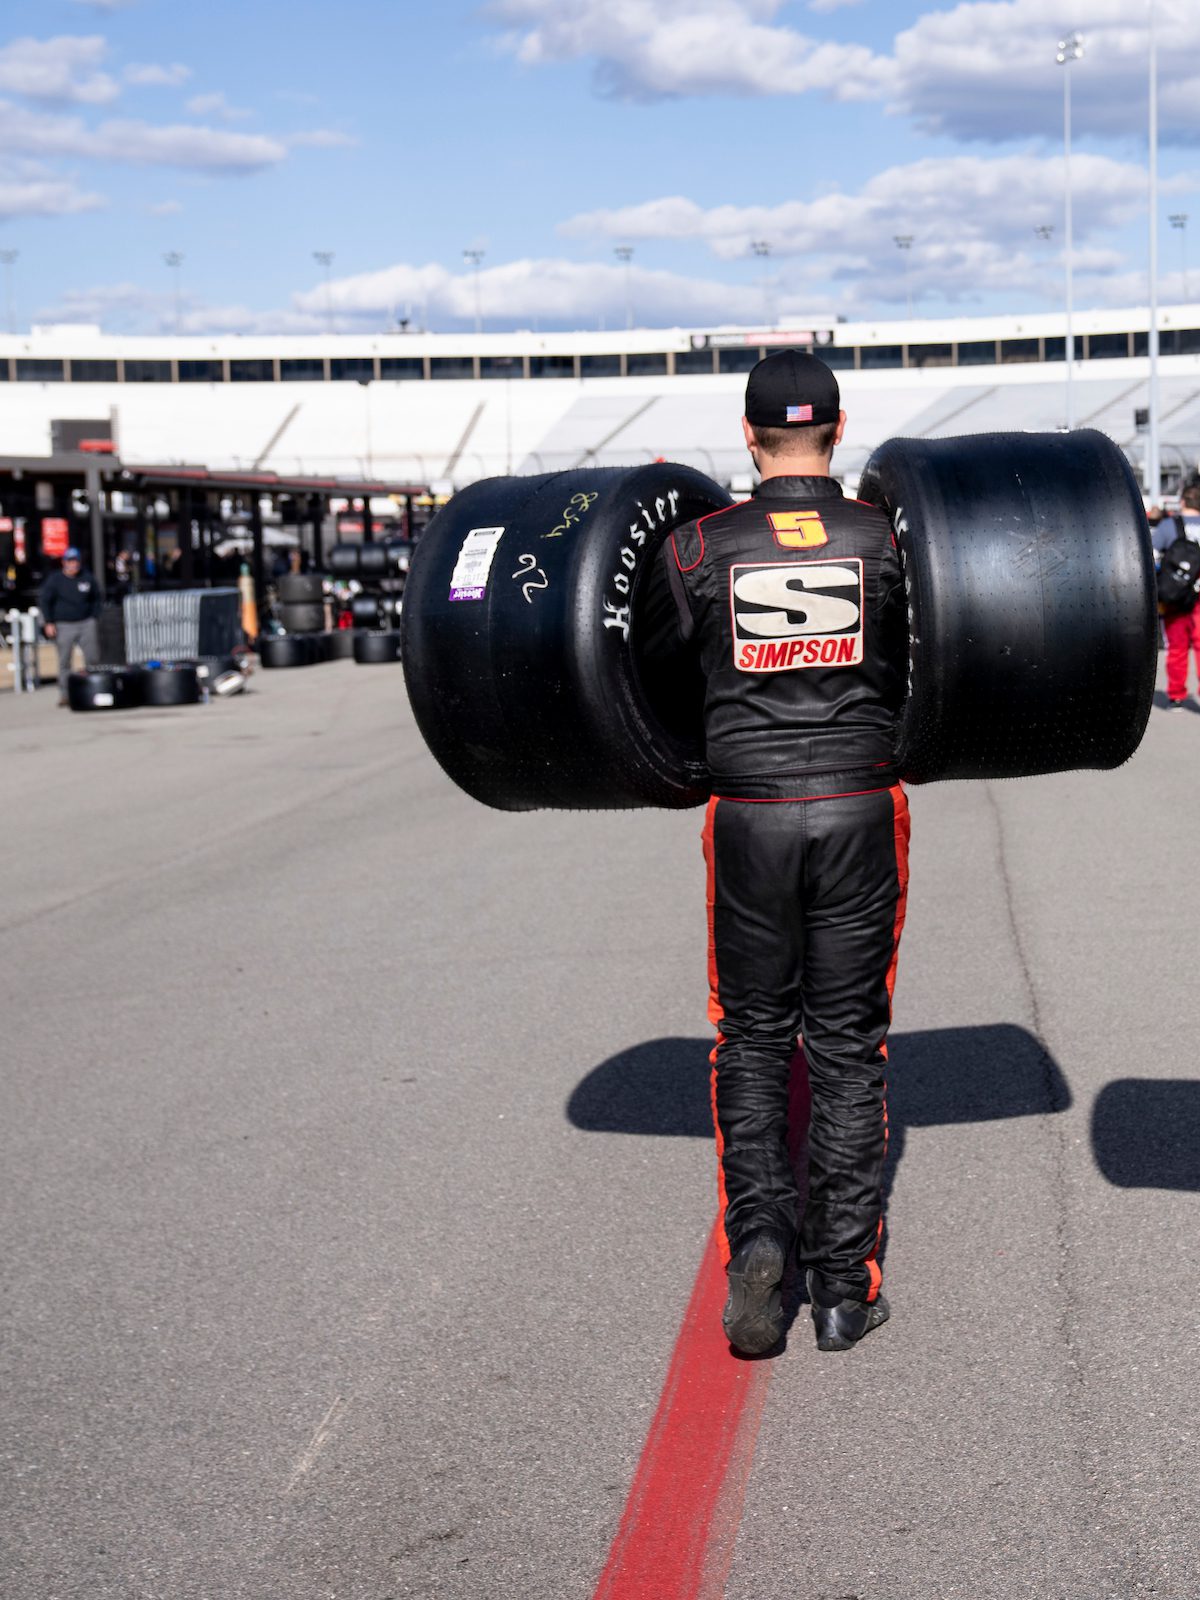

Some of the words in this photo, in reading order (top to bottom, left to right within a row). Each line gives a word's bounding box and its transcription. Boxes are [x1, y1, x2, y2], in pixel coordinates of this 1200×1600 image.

[766, 511, 829, 549] 5
[602, 489, 679, 643] Hoosier
[734, 566, 859, 637] S
[739, 637, 857, 669] SIMPSON
